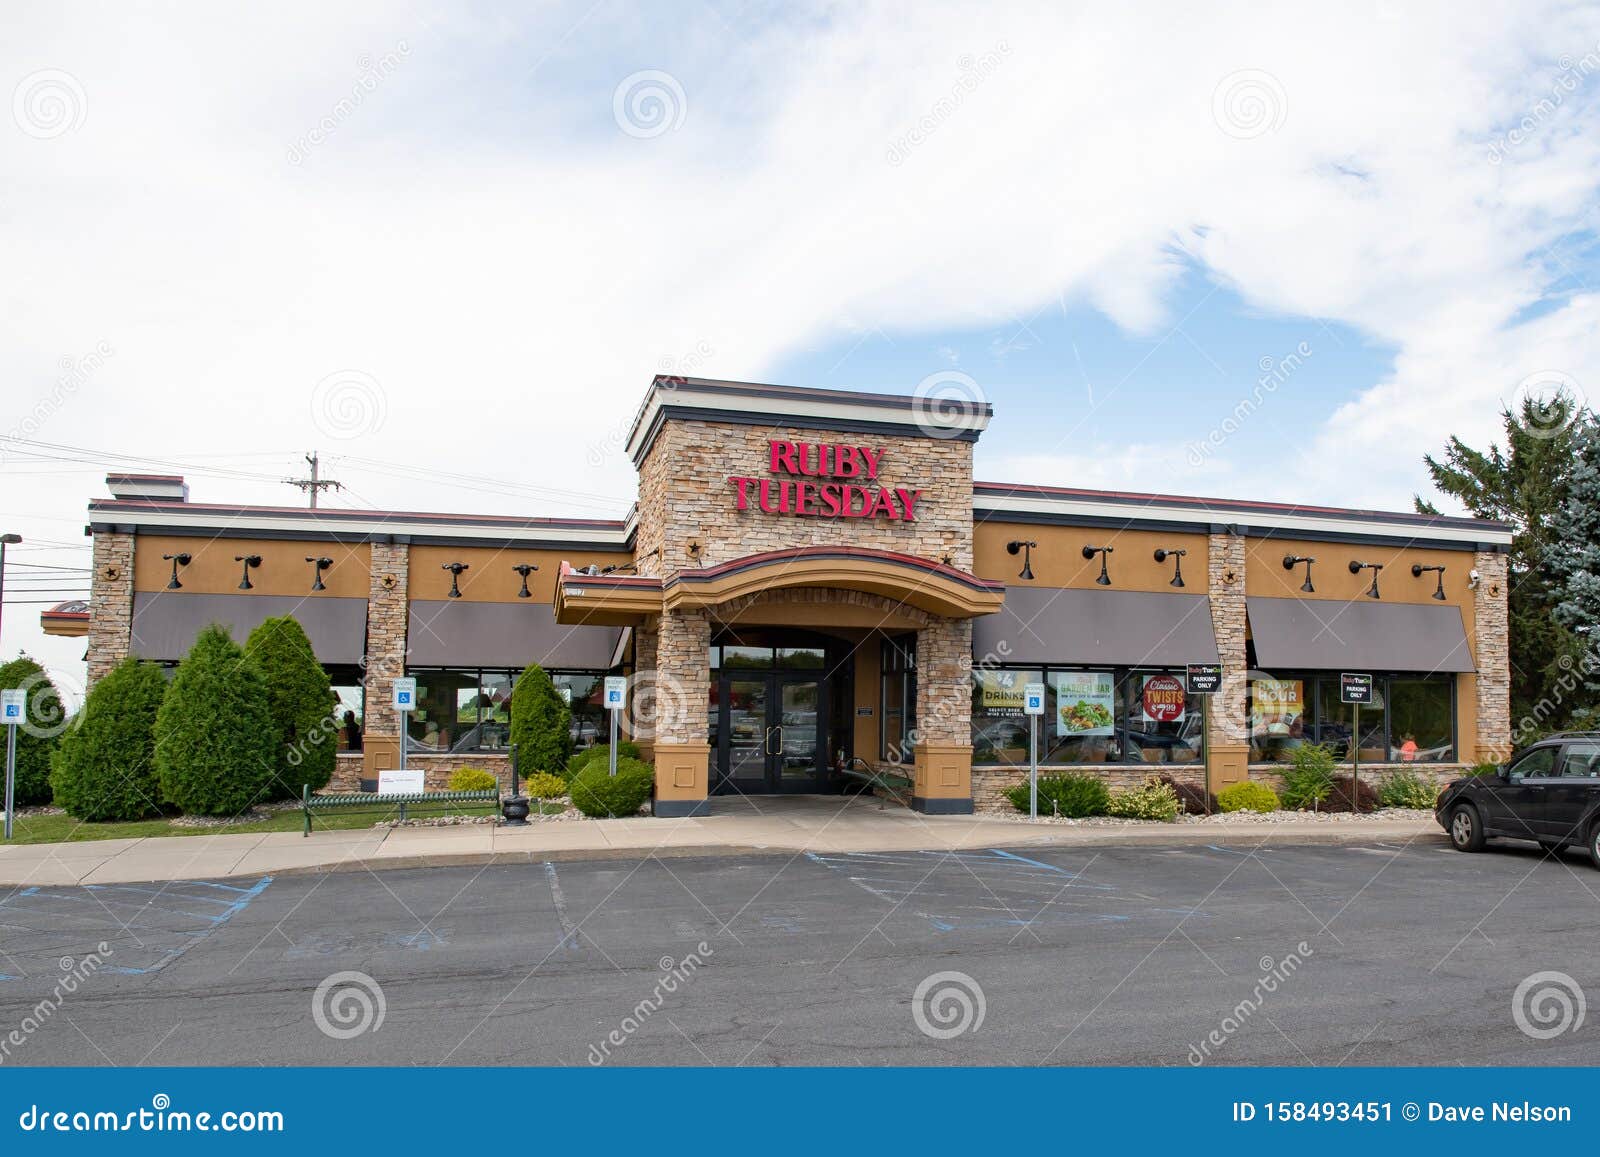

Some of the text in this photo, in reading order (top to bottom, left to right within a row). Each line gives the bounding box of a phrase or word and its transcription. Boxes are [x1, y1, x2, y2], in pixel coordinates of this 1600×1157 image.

[768, 439, 887, 479] RUBY
[727, 476, 924, 521] TUESDAY
[1149, 680, 1179, 691] Classic
[985, 691, 1025, 700] DRINKS
[1145, 690, 1184, 704] TWISTS
[1258, 690, 1297, 702] HOUR
